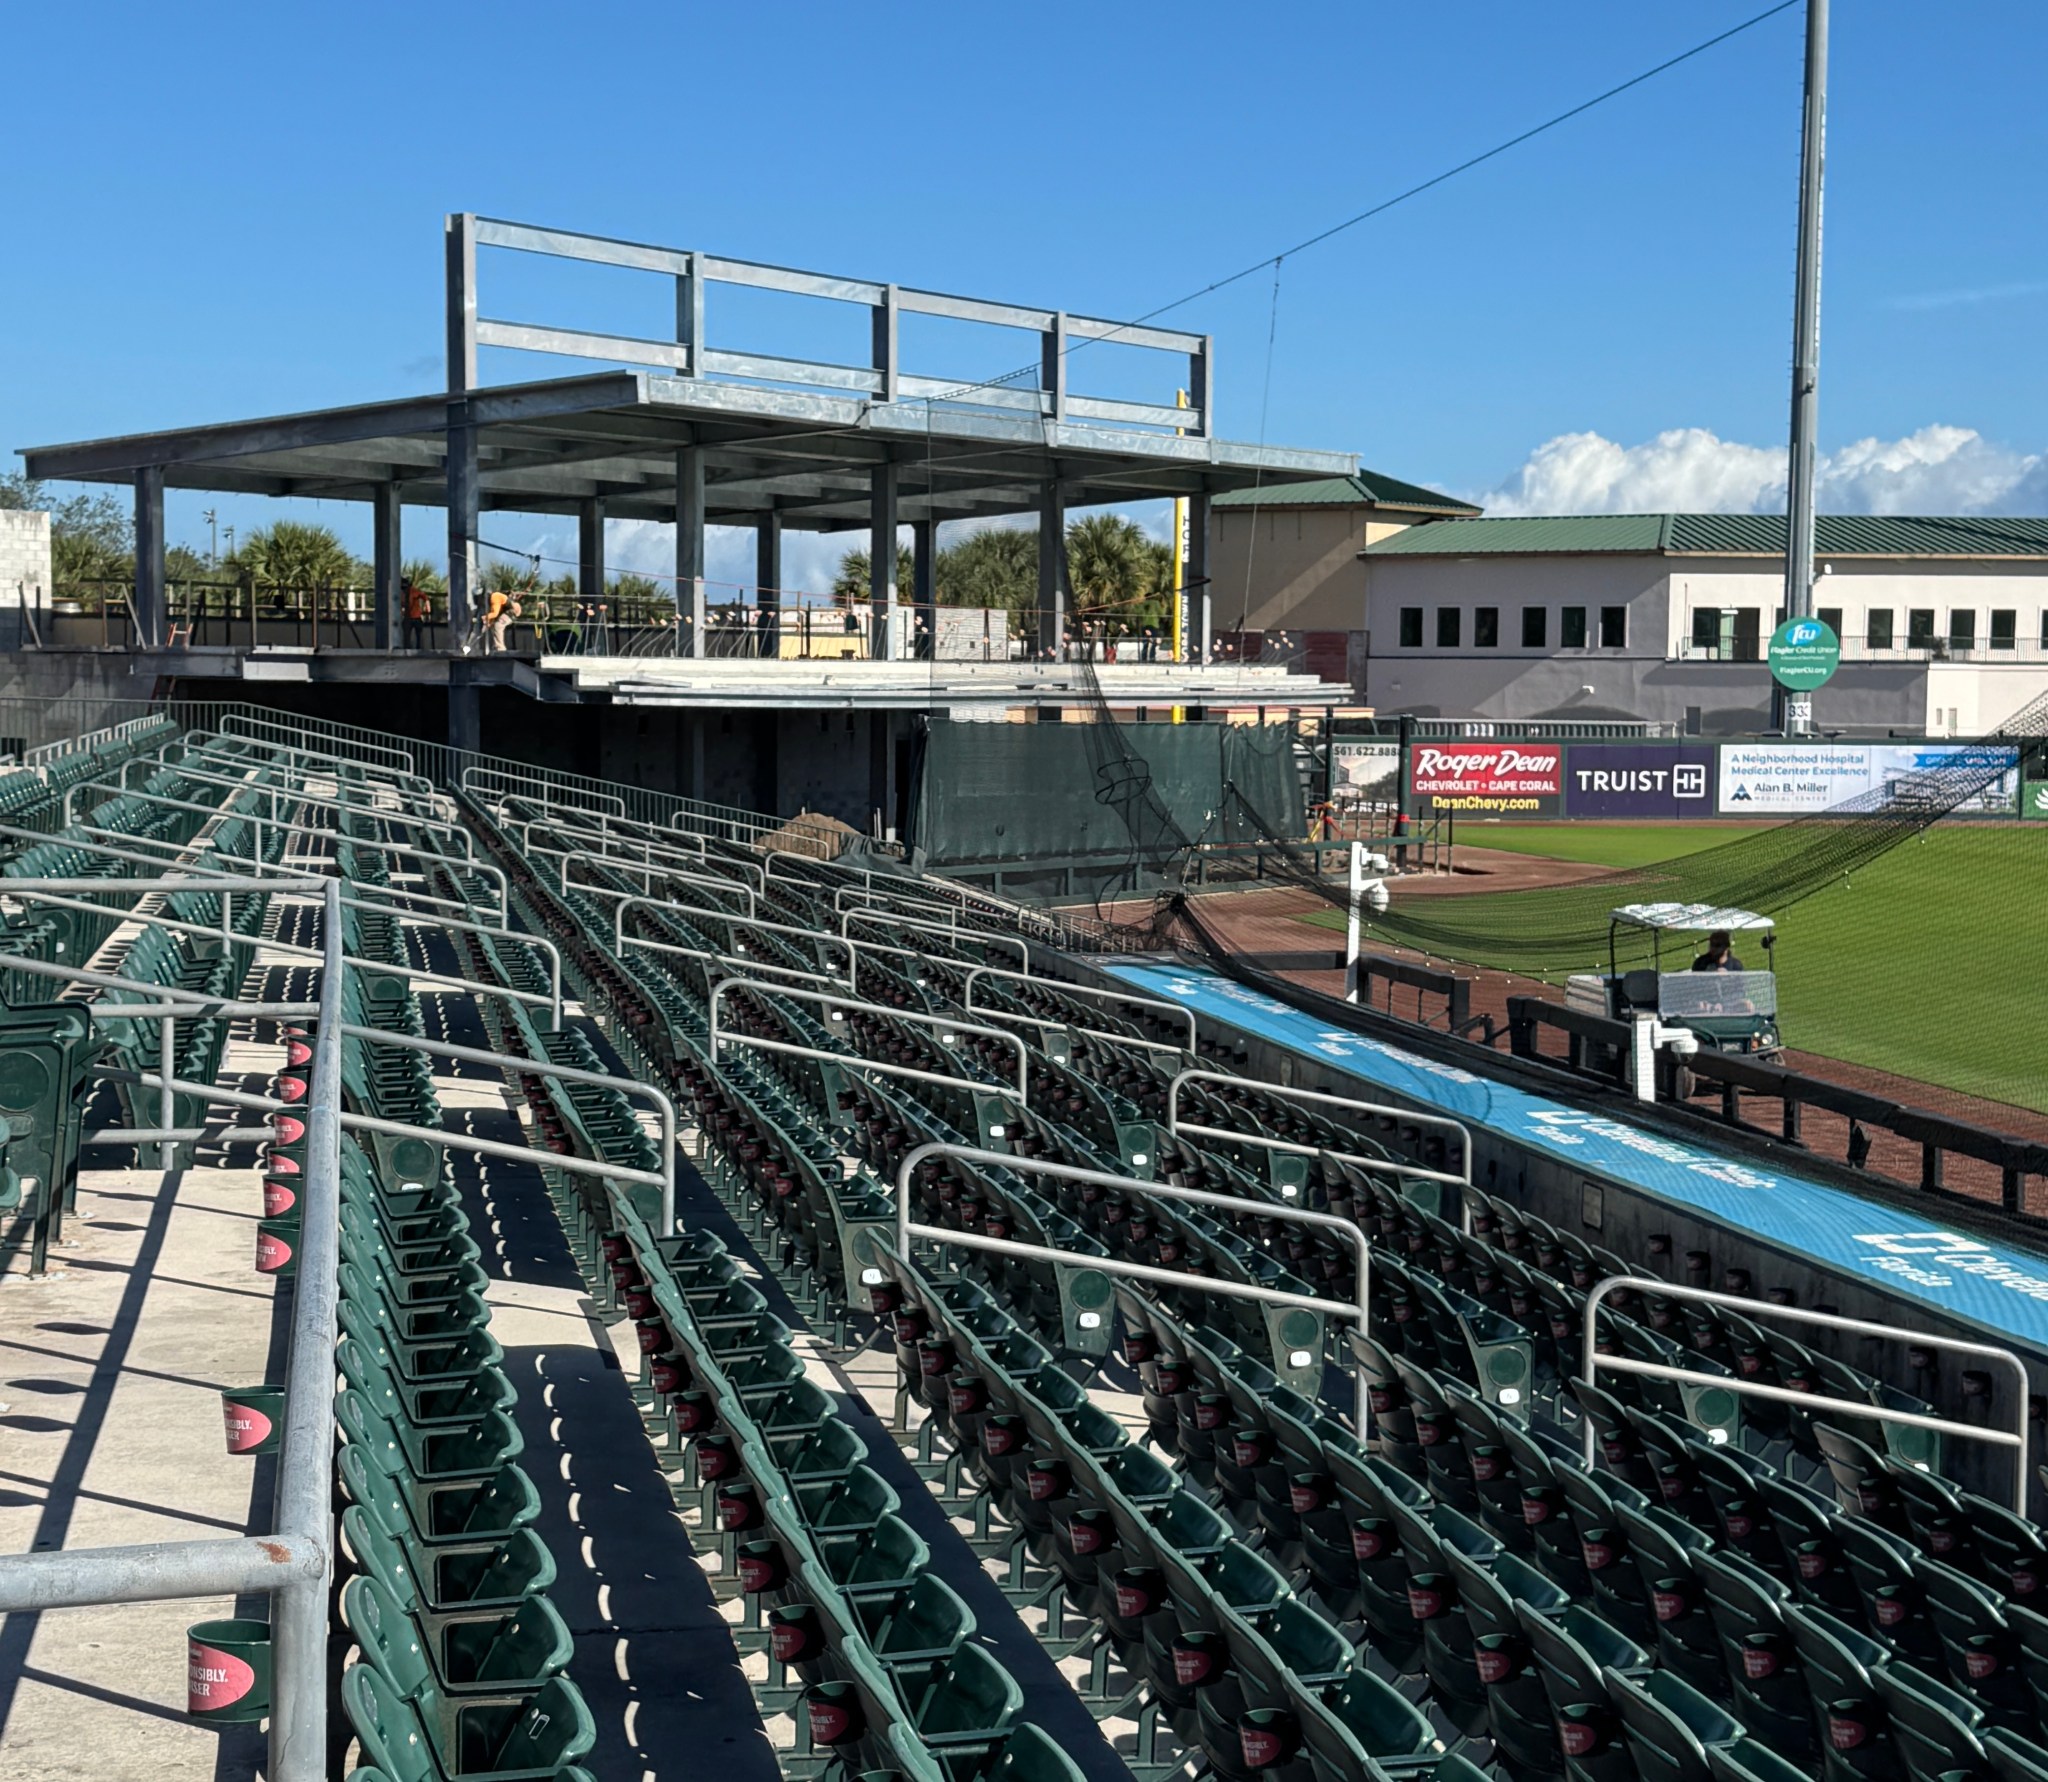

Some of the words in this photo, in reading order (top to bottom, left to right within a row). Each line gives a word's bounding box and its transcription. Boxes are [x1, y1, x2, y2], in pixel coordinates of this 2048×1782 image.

[1333, 746, 1399, 757] 561.622.888
[1416, 749, 1497, 779] Roger
[1494, 749, 1556, 777] Dean
[1731, 754, 1740, 763] A
[1742, 753, 1818, 765] Neighborhood
[1820, 753, 1864, 765] Hospital
[1731, 766, 1773, 776] Medical
[1774, 766, 1810, 776] Center
[1812, 766, 1868, 776] Excellence
[1416, 780, 1479, 791] CHEVROLET
[1488, 780, 1518, 791] CAPE
[1519, 780, 1556, 791] CORAL
[1576, 770, 1669, 792] TRUIST
[1754, 782, 1780, 793] Alan
[1783, 783, 1794, 793] B.
[1796, 782, 1828, 793] Miller
[1432, 796, 1540, 812] DeanChevy.com
